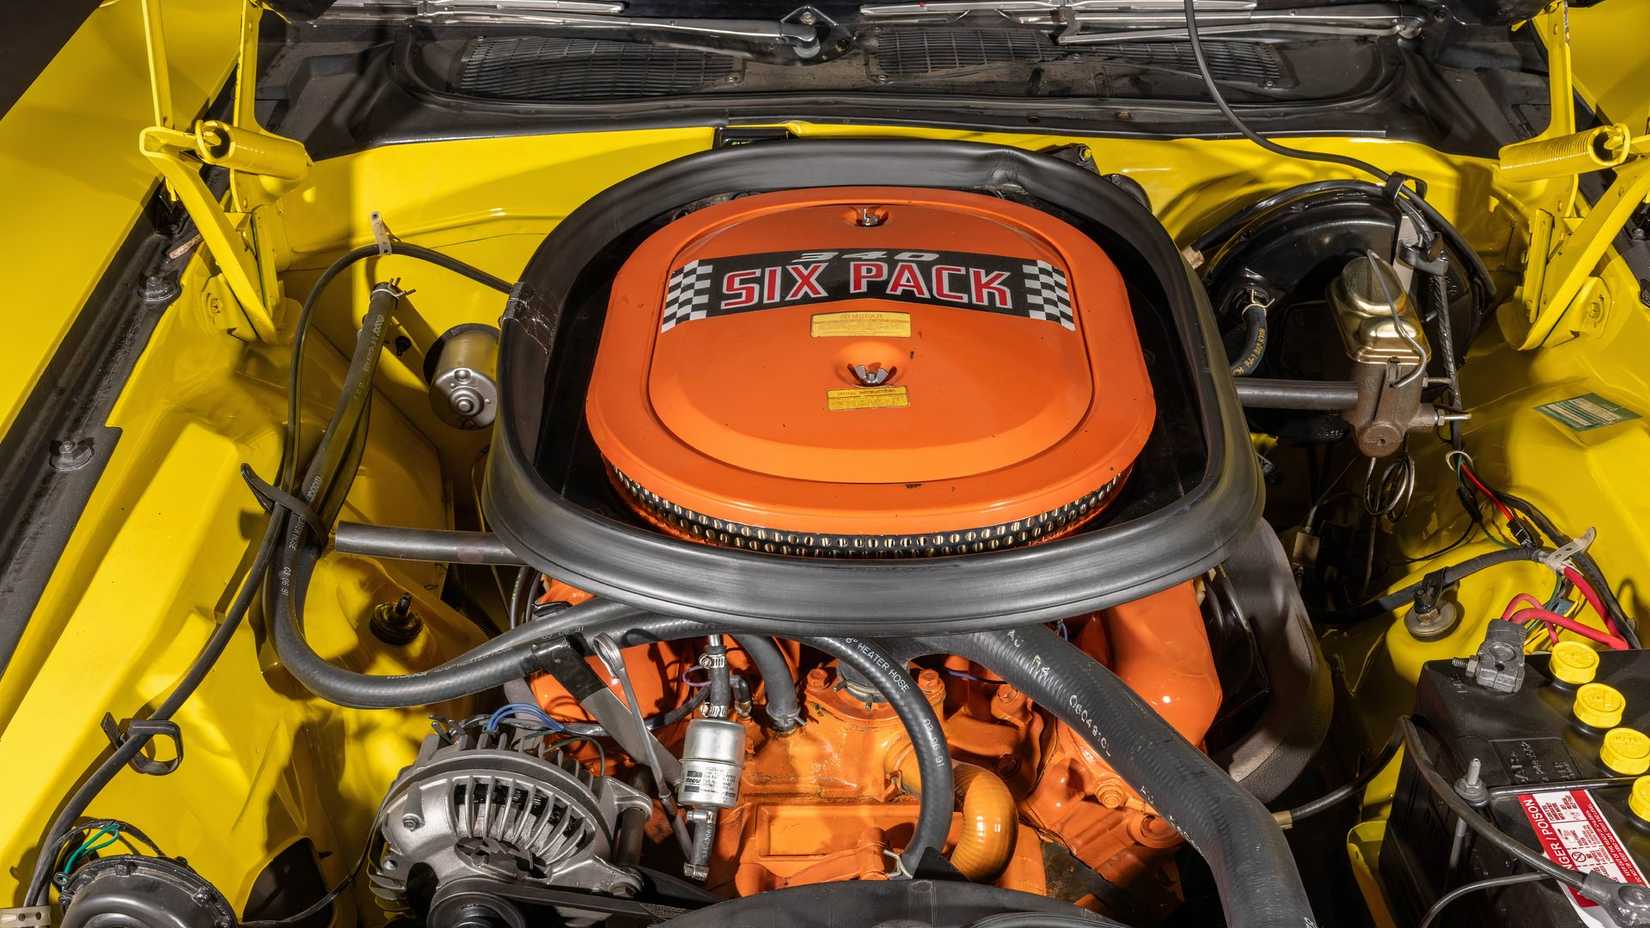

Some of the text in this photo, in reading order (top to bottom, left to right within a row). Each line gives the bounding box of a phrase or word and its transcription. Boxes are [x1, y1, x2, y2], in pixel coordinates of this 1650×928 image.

[791, 251, 939, 263] 340
[720, 261, 1013, 309] SIX PACK
[857, 642, 890, 673] HEATER
[888, 668, 911, 693] HOSE
[1522, 798, 1553, 836] POISON
[1550, 841, 1577, 871] NGER
